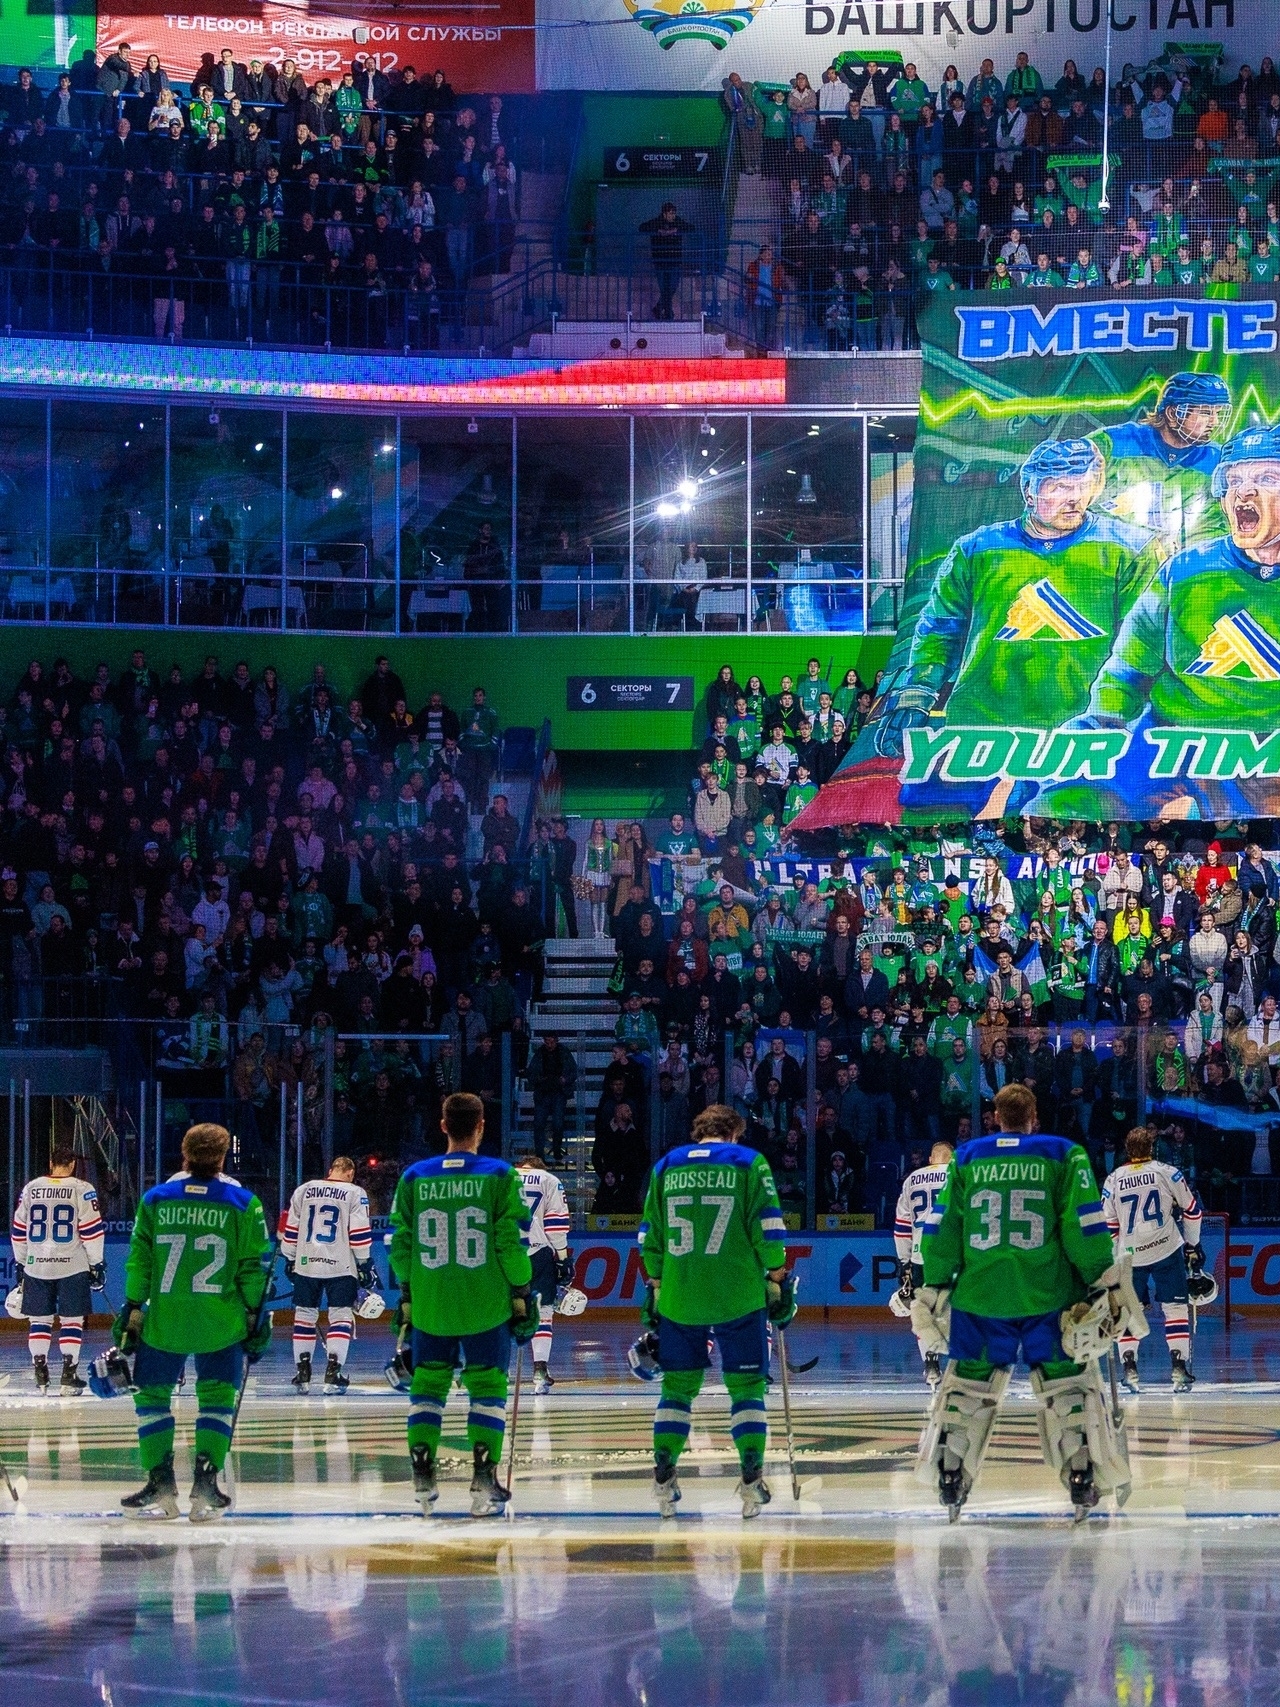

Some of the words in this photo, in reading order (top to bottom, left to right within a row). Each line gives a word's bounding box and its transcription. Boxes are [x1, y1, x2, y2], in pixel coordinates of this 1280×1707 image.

[164, 14, 263, 35] ТЕЛЕФОН
[407, 27, 501, 42] СЛУЖБЫ
[805, 0, 1234, 36] БАШКОРТОСТАН
[615, 153, 630, 172] 6
[694, 153, 708, 171] 7
[954, 298, 1277, 361] ВМЕСТЕ
[581, 683, 596, 703] 6
[666, 683, 680, 703] 7
[900, 724, 1129, 783] YOUR
[664, 1170, 736, 1191] BROSSEAU
[911, 1173, 946, 1186] ROMANO
[973, 1163, 1045, 1183] VYAZOVOI
[1119, 1173, 1156, 1191] ZHUKOV
[31, 1187, 73, 1199] SETDIKOV
[305, 1186, 349, 1201] SAWCHUK
[418, 1180, 484, 1201] GAZIMOV
[158, 1207, 228, 1228] SUCHKOV
[969, 1189, 1047, 1250] 35
[1120, 1189, 1164, 1235] 74
[29, 1204, 74, 1242] 88
[305, 1204, 340, 1243] 13
[666, 1195, 735, 1256] 57
[418, 1206, 487, 1269] 96
[156, 1233, 227, 1293] 72
